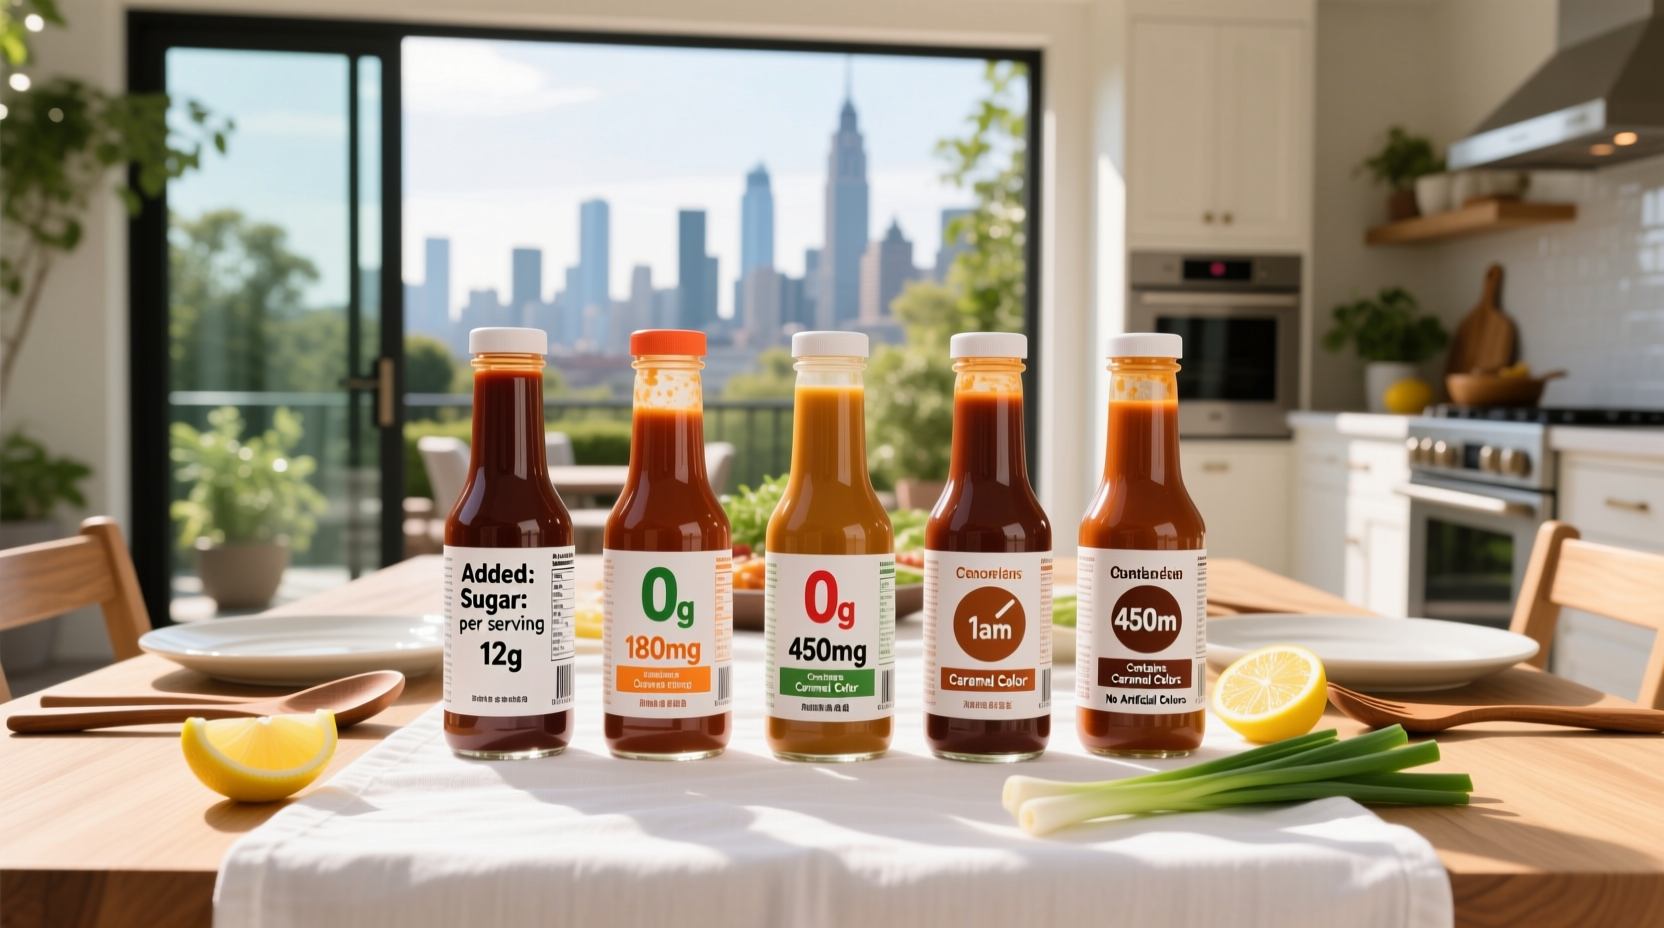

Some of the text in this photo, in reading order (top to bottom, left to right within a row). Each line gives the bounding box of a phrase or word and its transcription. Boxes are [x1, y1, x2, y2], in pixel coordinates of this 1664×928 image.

[461, 562, 535, 584] Added:
[460, 587, 527, 615] Sugar:
[641, 566, 695, 629] 0g
[804, 569, 855, 630] 0g
[459, 615, 545, 635] per serving
[968, 615, 1012, 640] 1am
[1114, 607, 1177, 632] 450m
[480, 641, 522, 673] 12g
[625, 634, 701, 666] 180mg
[788, 636, 867, 668] 450mg
[997, 673, 1029, 688] Color
[1106, 693, 1118, 704] No
